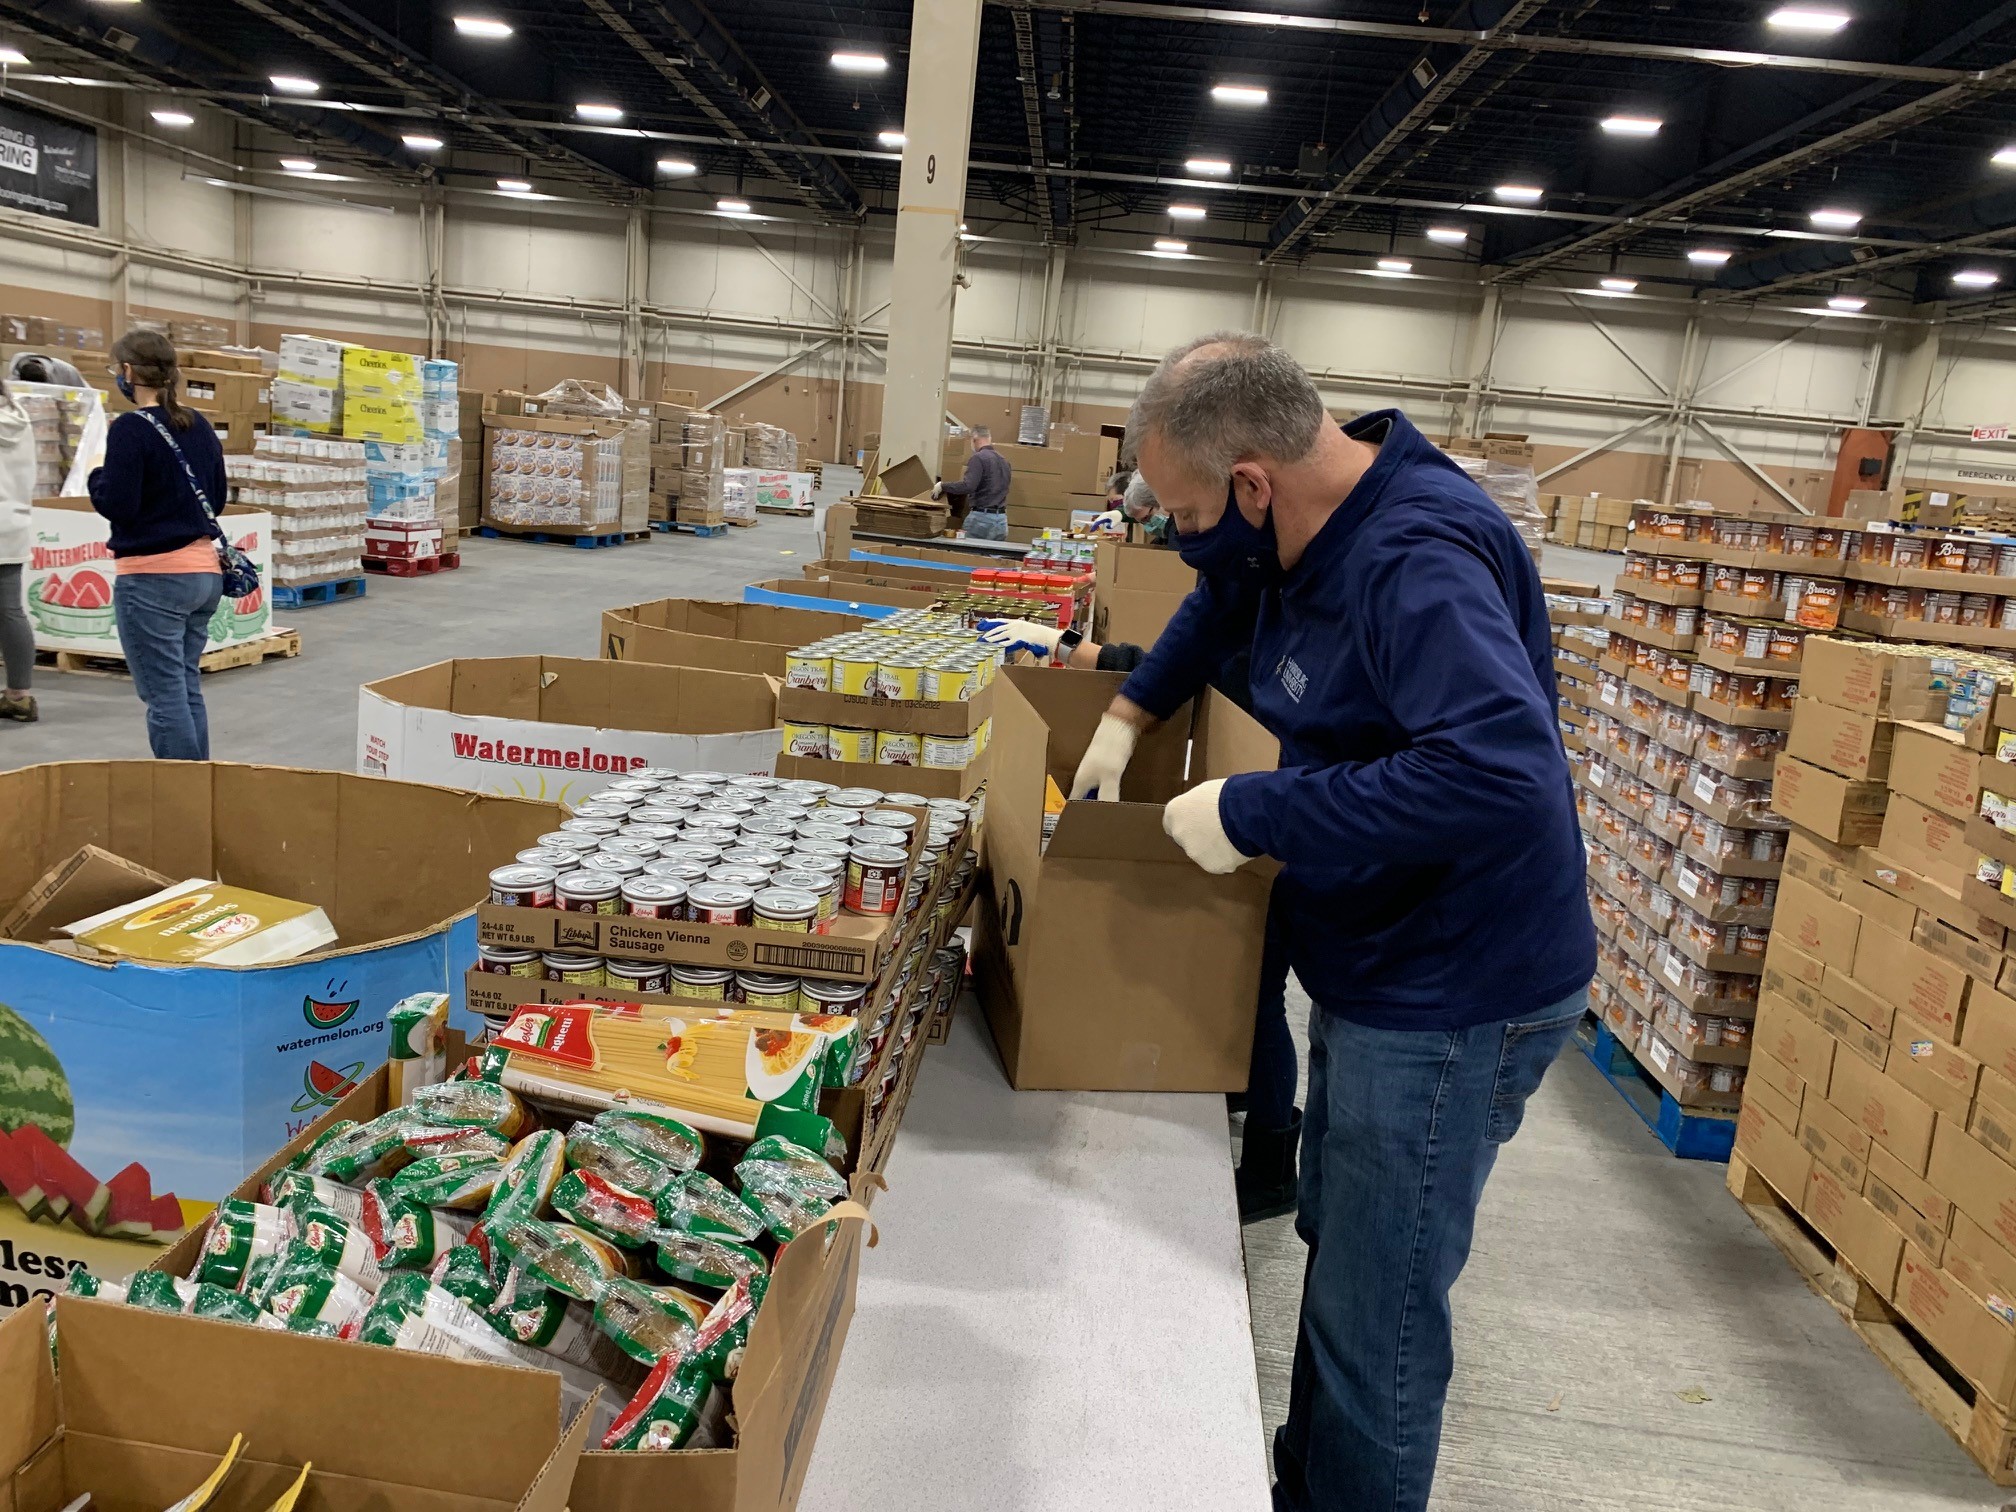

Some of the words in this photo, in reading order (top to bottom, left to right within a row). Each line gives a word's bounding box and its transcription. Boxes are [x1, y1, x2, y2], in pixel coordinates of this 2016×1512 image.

[926, 154, 936, 184] 9
[360, 358, 387, 369] Cheerios
[360, 403, 387, 415] Cheerios
[1978, 428, 2009, 440] EXIT
[1958, 470, 2003, 480] EMERGENCY
[1806, 581, 1837, 596] Bruce's
[1808, 595, 1831, 606] YAMS
[786, 670, 828, 688] Cranberry
[871, 697, 888, 706] BEST
[370, 734, 386, 748] WATCH
[366, 744, 378, 756] YOUR
[379, 750, 389, 761] STEP
[452, 732, 648, 774] Watermelons
[158, 902, 239, 937] Spaghetti
[481, 921, 504, 931] 24-4.6
[505, 923, 515, 932] OZ
[481, 931, 495, 940] NET
[496, 932, 508, 942] WT
[521, 933, 536, 944] LBS
[561, 926, 594, 942] Libby's
[609, 925, 662, 941] Chicken
[666, 930, 711, 945] Vienna
[609, 937, 665, 953] Sausage
[470, 989, 492, 998] 24-4.6
[493, 992, 502, 1000] OZ
[470, 1000, 483, 1008] NET
[484, 1001, 495, 1009] WT
[276, 1020, 385, 1053] watermelon.org
[520, 1016, 536, 1043] esler
[550, 1016, 575, 1051] aghetti
